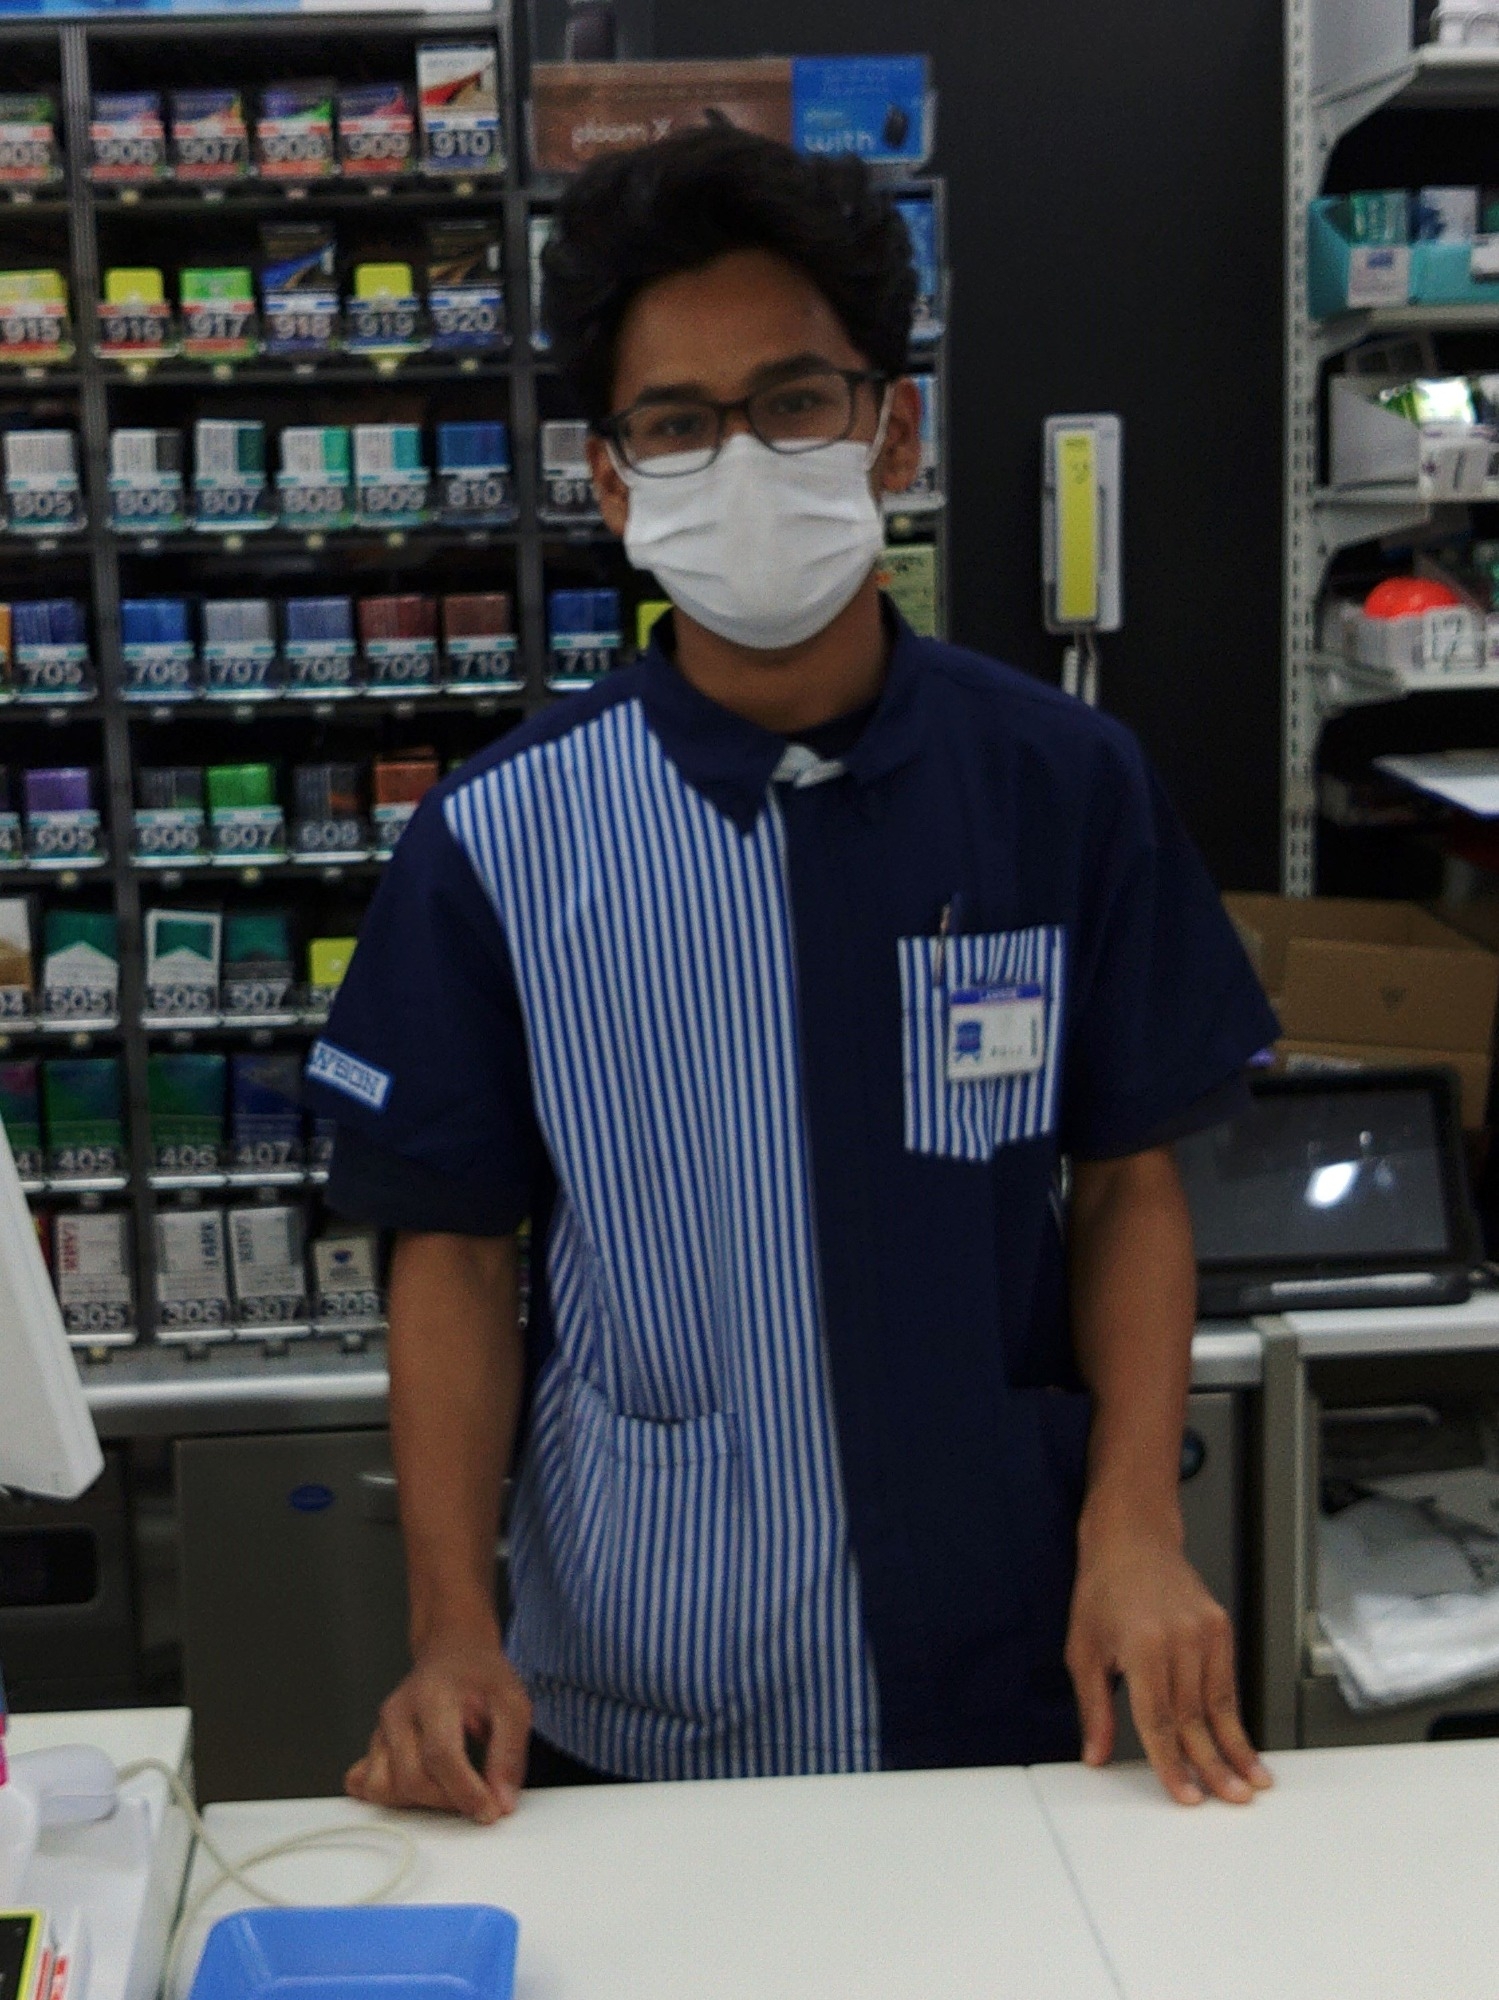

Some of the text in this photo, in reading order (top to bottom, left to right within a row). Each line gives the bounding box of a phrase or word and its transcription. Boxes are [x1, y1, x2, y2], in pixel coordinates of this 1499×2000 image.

[434, 131, 491, 158] 910
[5, 316, 60, 344] 915
[107, 316, 164, 342] 916
[191, 311, 246, 338] 917
[434, 305, 497, 333] 920
[26, 660, 84, 686] 705
[130, 659, 190, 683] 706
[216, 657, 270, 683] 707
[375, 652, 431, 680] 709
[458, 651, 511, 677] 710
[219, 824, 277, 849] 607
